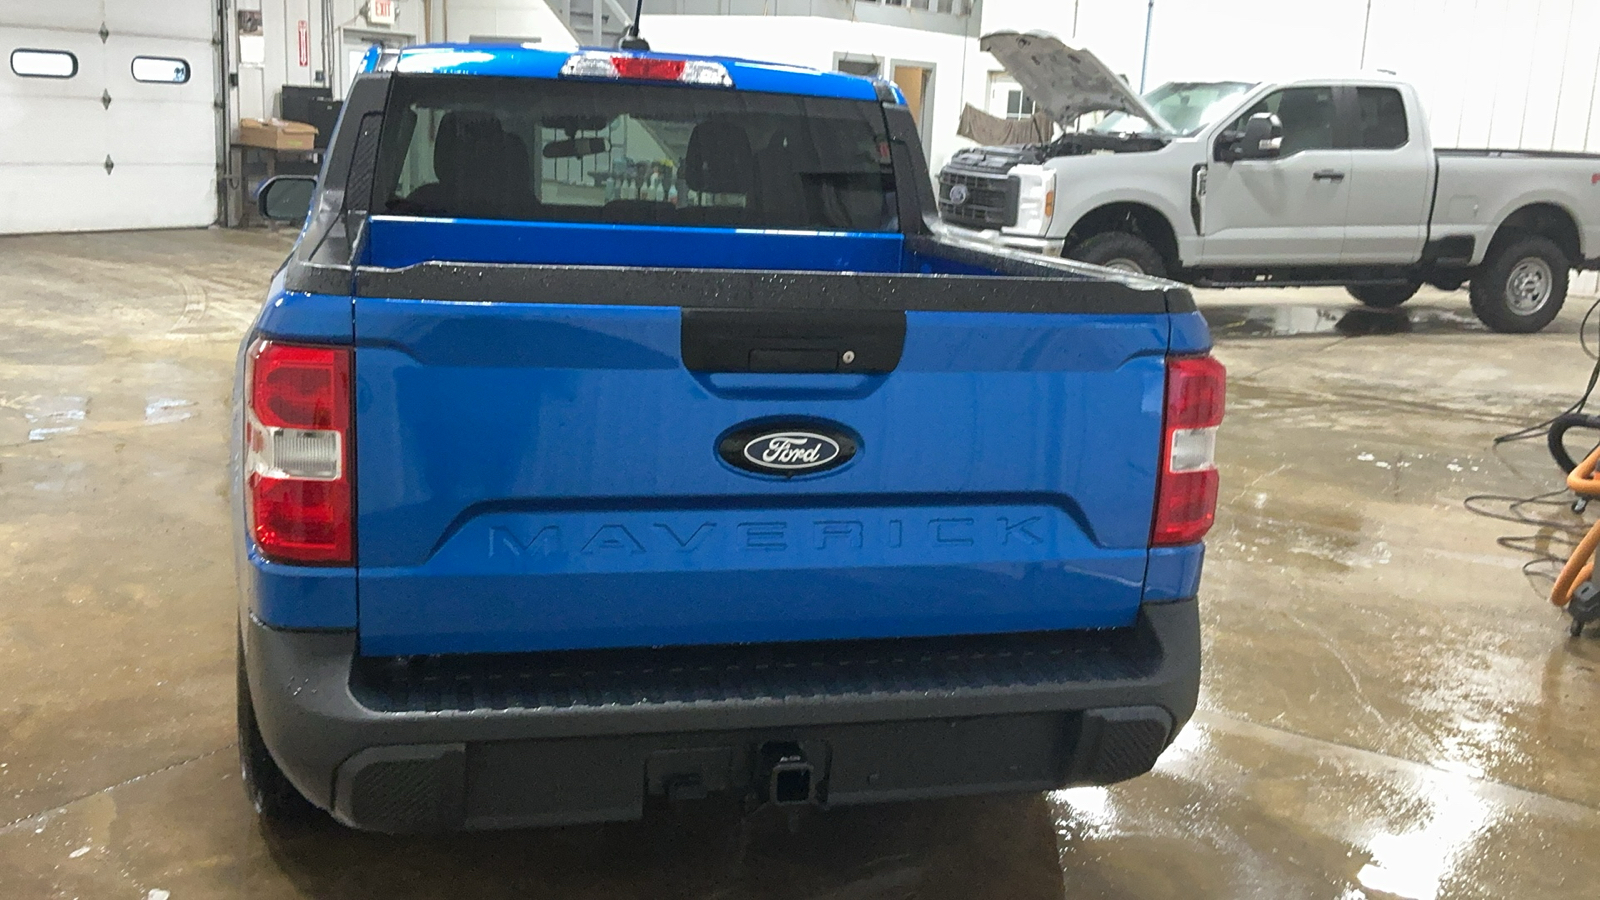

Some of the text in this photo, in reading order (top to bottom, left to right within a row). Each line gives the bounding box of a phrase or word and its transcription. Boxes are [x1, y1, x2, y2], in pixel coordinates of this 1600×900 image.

[375, 0, 391, 17] EXIT
[762, 437, 822, 463] Ford
[488, 516, 1044, 558] MAVERICK
